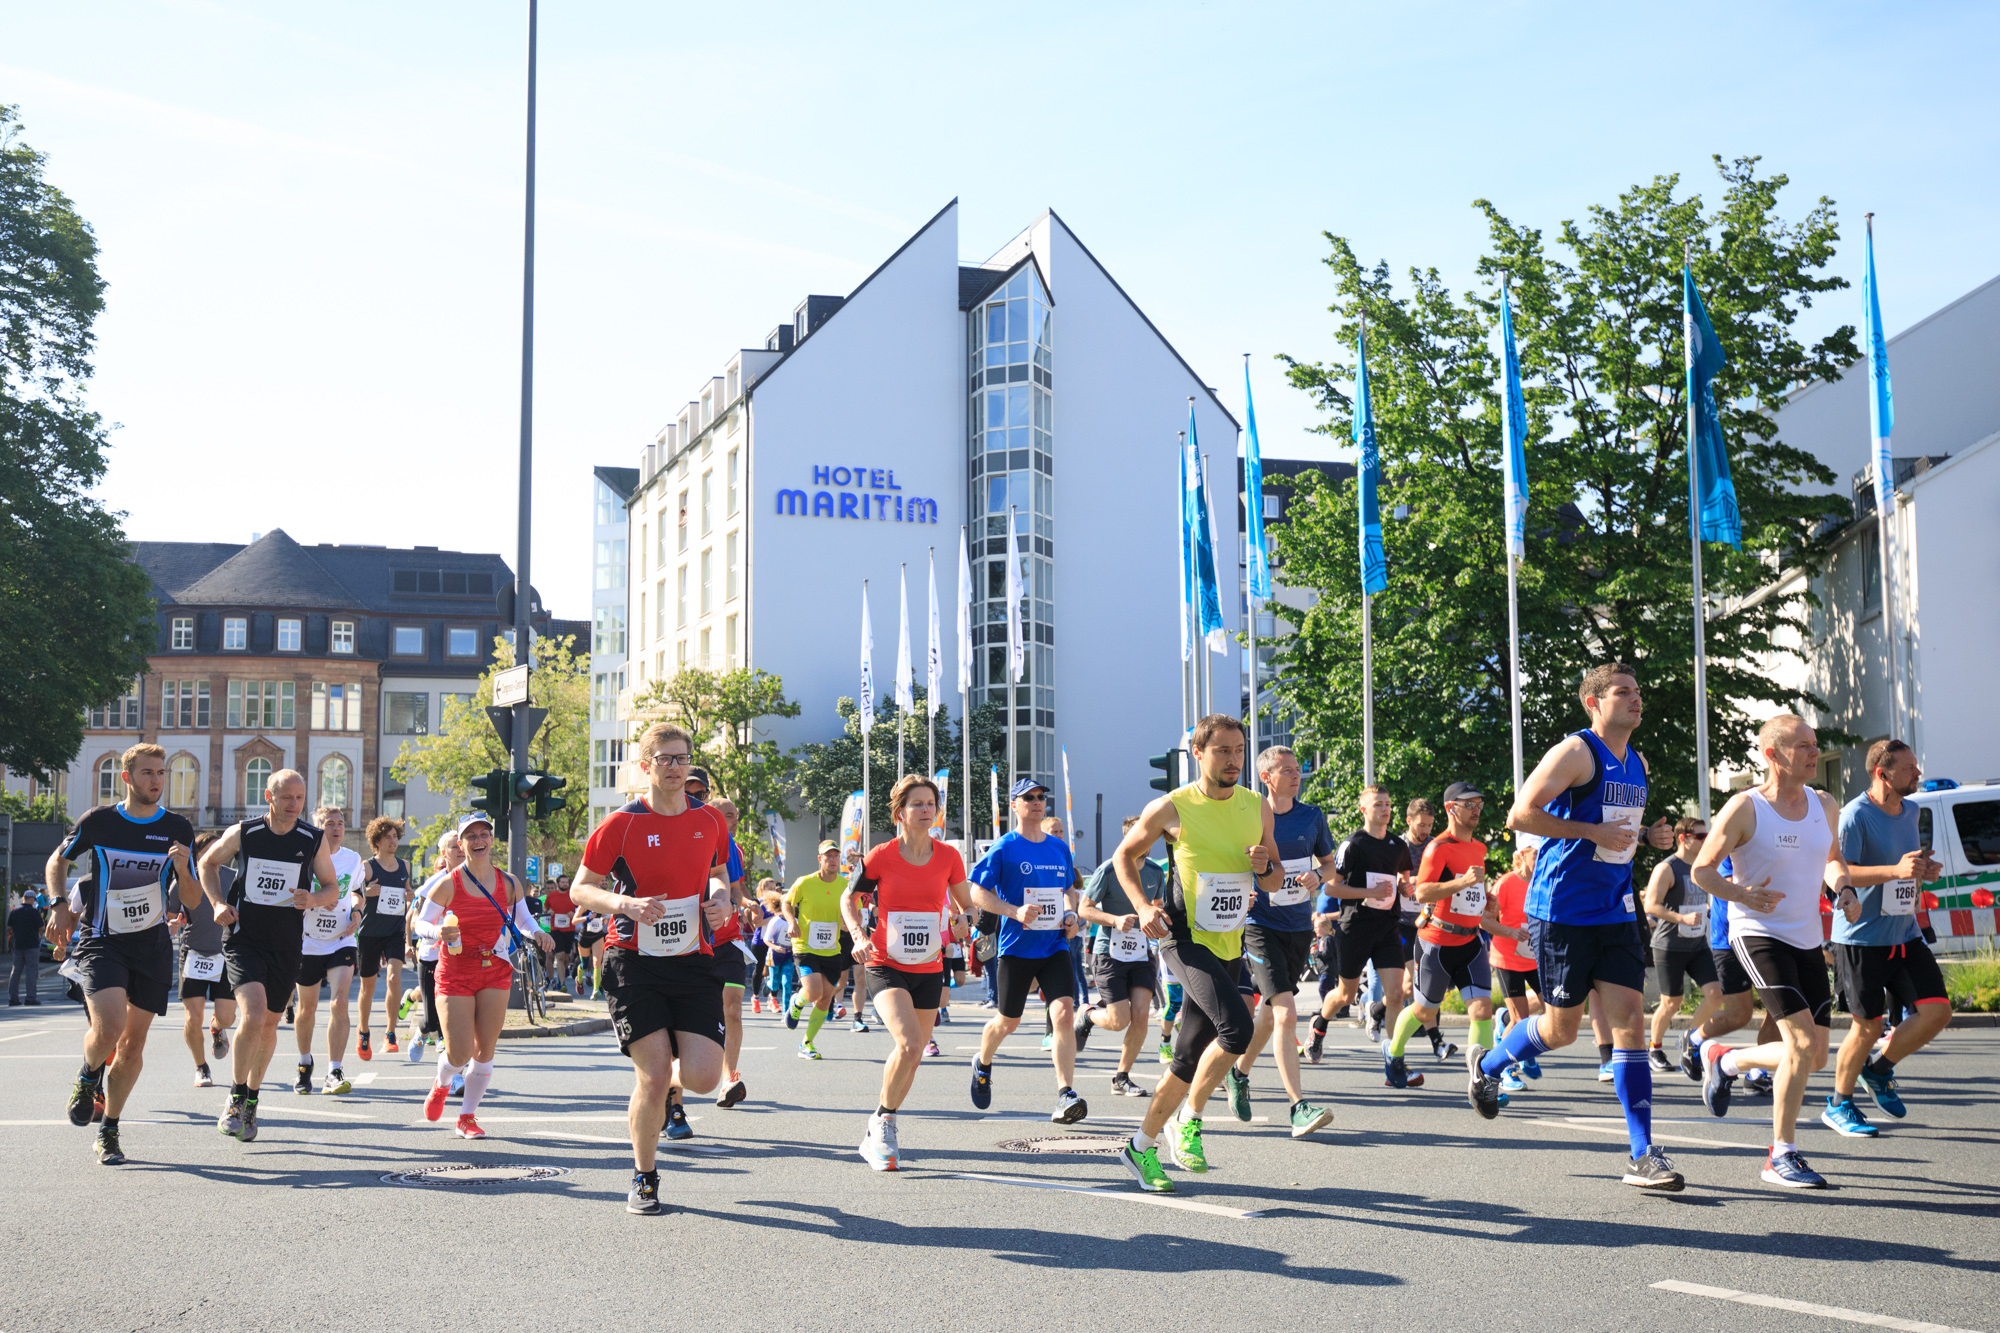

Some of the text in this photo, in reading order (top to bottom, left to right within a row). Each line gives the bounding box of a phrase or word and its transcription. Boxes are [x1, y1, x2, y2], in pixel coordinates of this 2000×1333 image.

[814, 465, 901, 490] HOTEL
[777, 489, 937, 523] MARITIM
[1603, 780, 1646, 807] DALLAS
[647, 834, 660, 847] PE
[1778, 835, 1797, 843] 1467
[112, 858, 160, 872] preh
[257, 877, 286, 891] 2367
[1465, 890, 1480, 902] 339
[1895, 886, 1915, 900] 1266
[123, 897, 147, 905] Halbmarathon
[387, 897, 399, 906] 352
[1211, 895, 1242, 911] 2503
[122, 902, 150, 918] 1916
[316, 918, 337, 929] 2132
[653, 920, 687, 937] 1896
[662, 937, 681, 945] Patrick
[816, 933, 832, 941] 1632
[902, 932, 929, 946] 1091
[1121, 940, 1138, 951] 362
[194, 960, 214, 971] 2152
